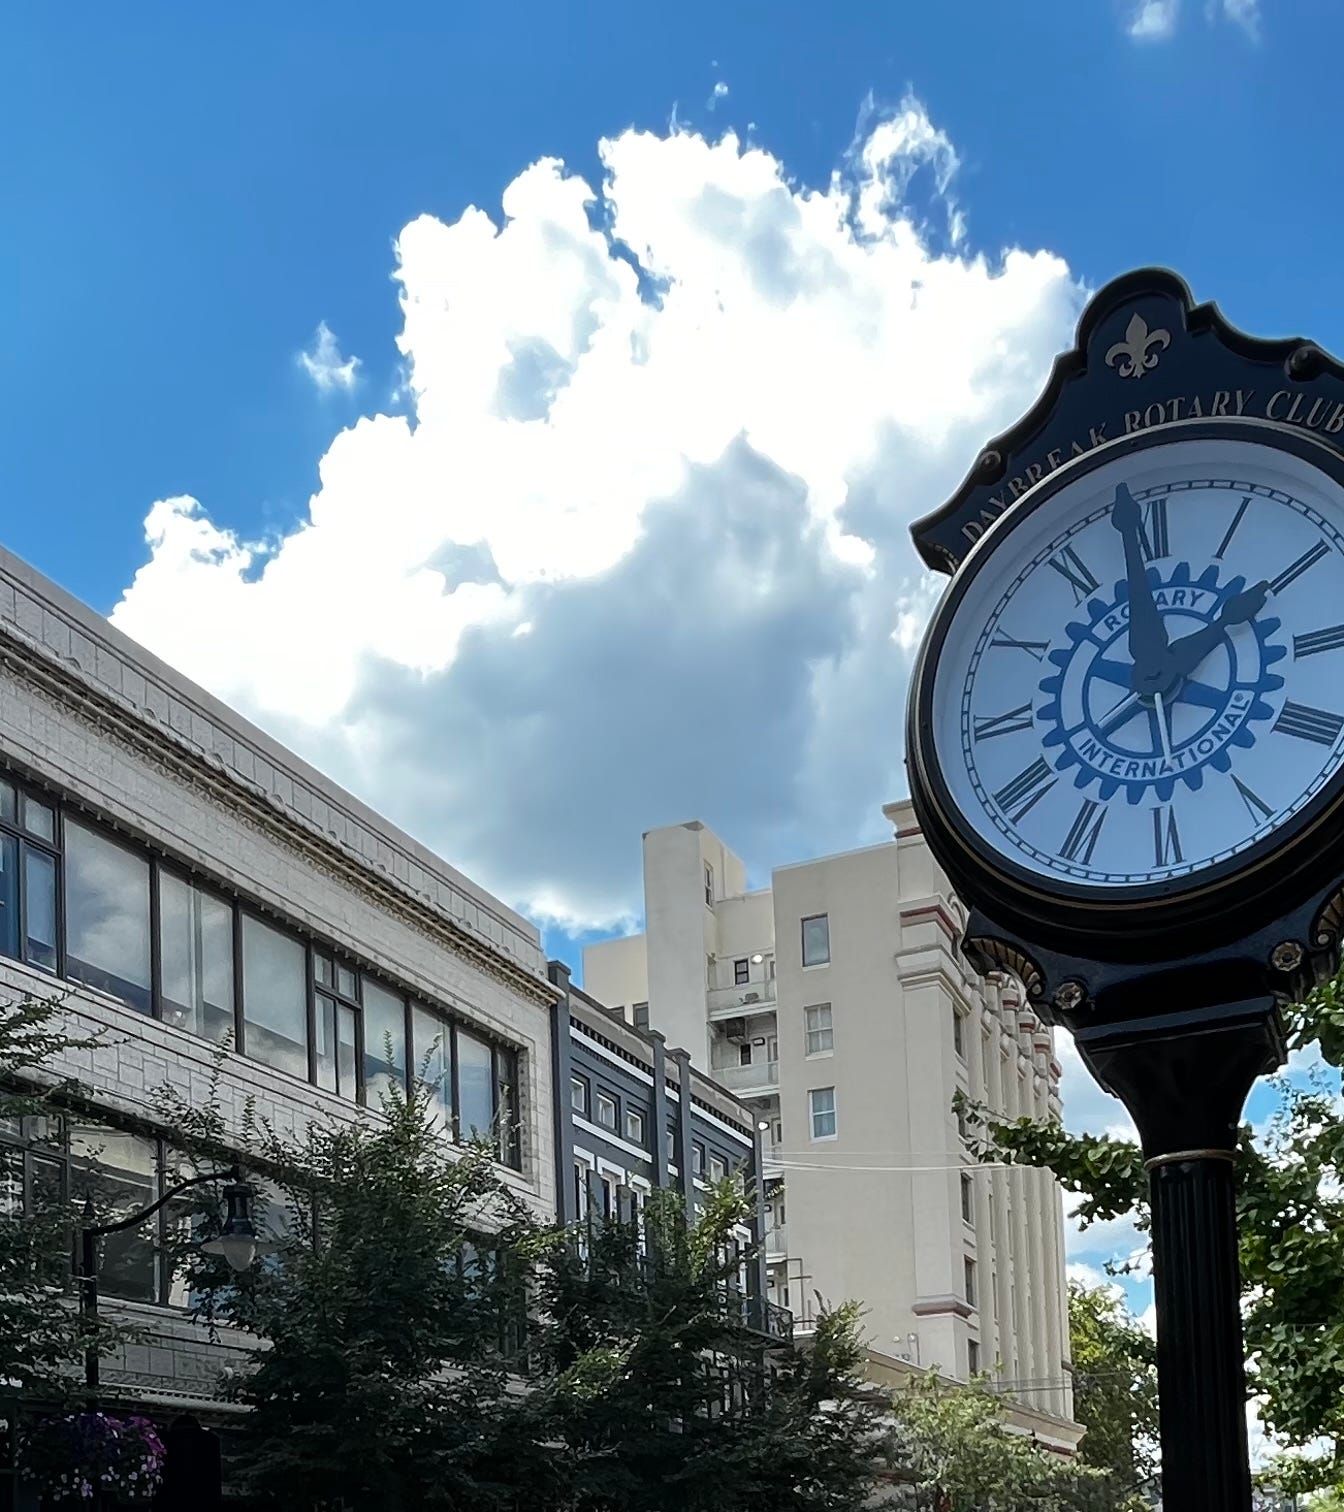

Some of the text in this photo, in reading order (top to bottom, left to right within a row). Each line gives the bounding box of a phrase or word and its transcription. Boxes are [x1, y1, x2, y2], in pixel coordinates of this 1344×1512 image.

[961, 422, 1108, 544] DAYBREAK
[1123, 389, 1255, 434] ROTARY
[1103, 589, 1205, 632] ROARY
